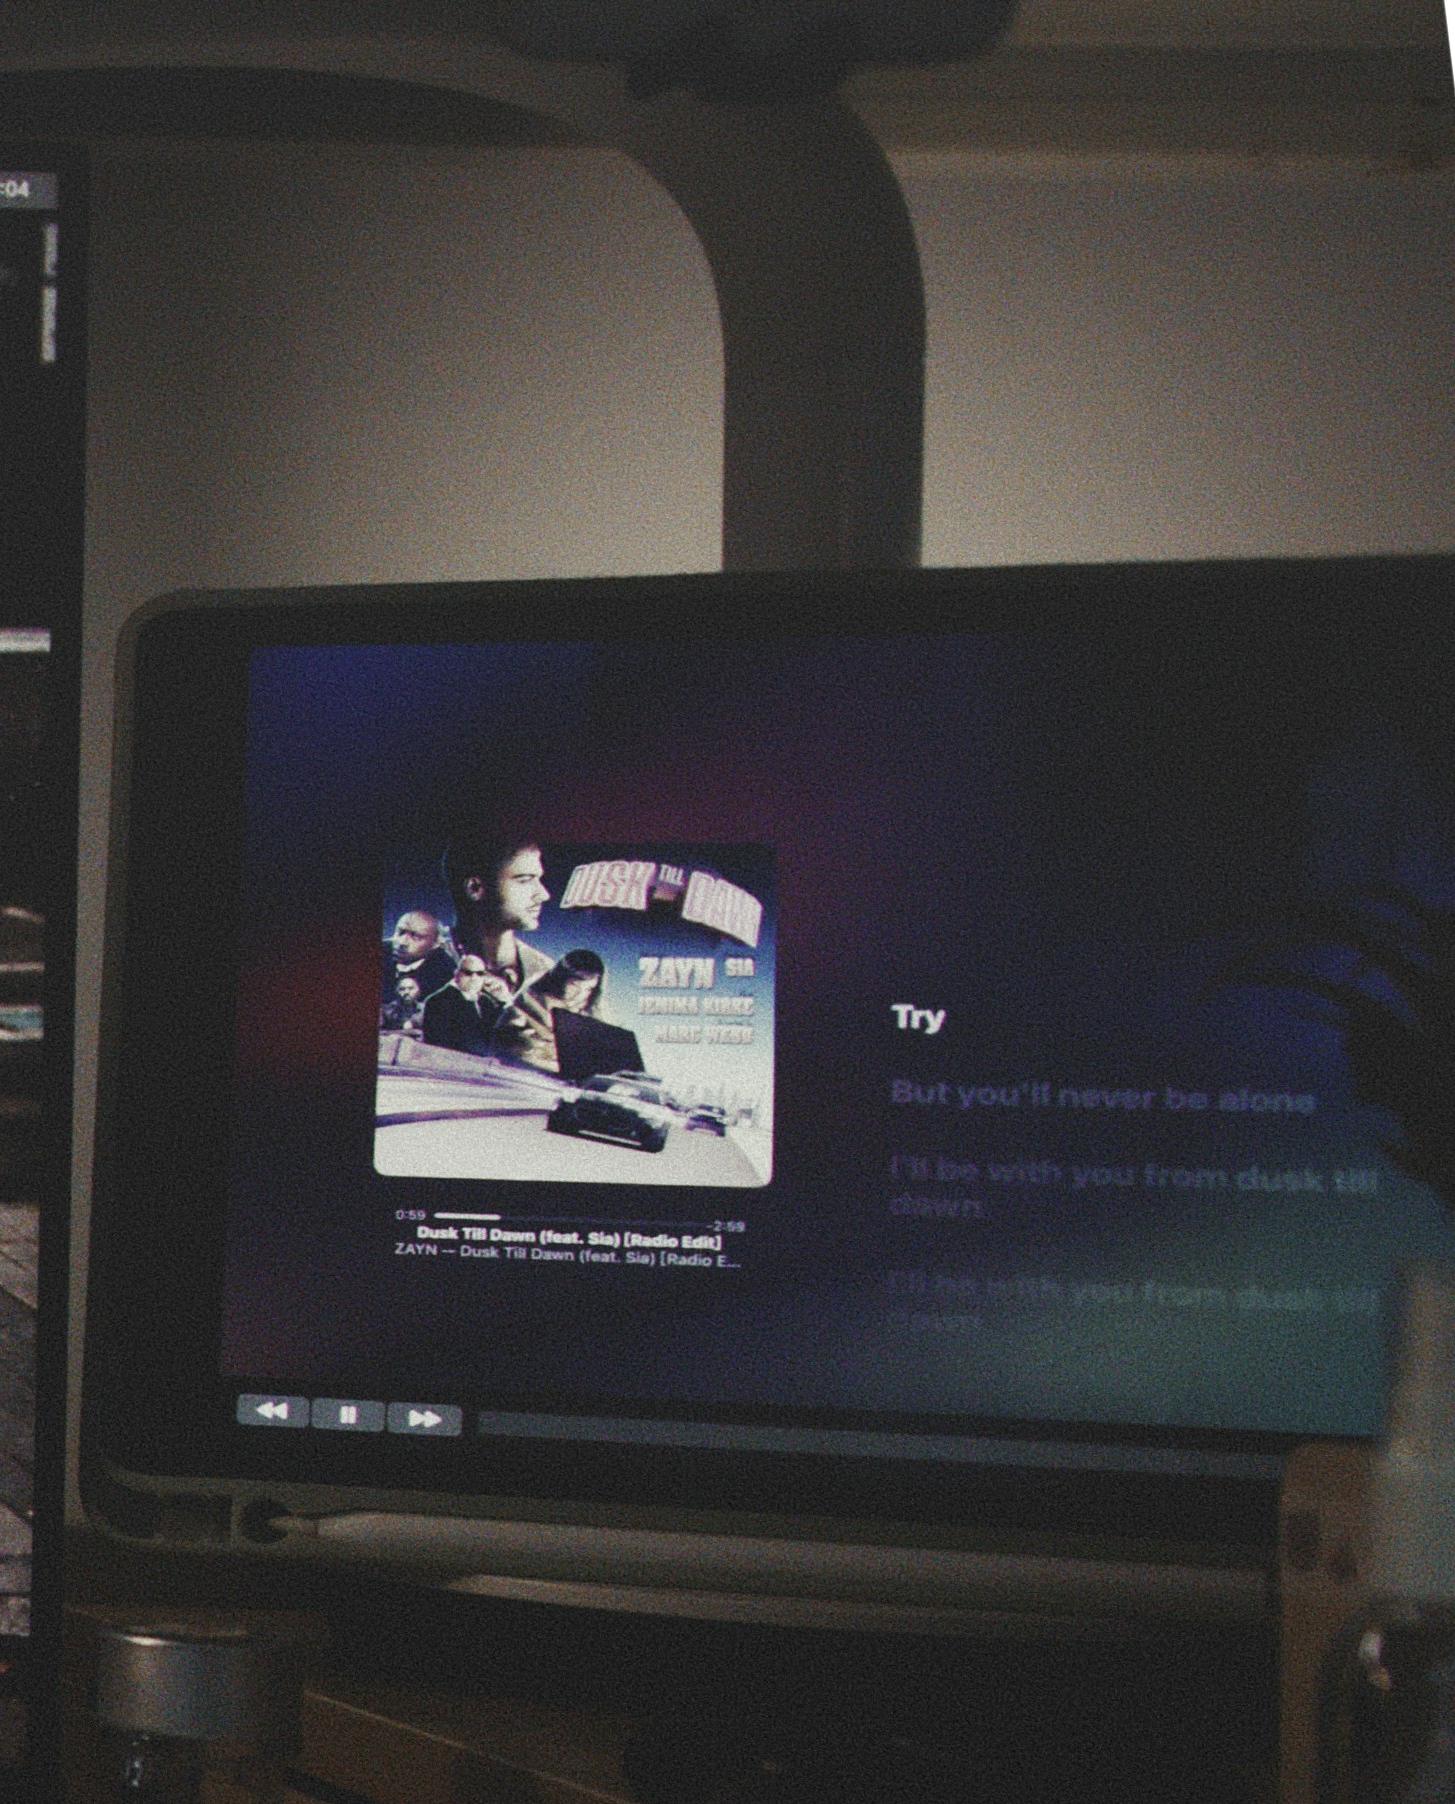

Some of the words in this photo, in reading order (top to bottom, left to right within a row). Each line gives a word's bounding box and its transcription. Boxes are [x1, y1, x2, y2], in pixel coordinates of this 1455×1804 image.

[638, 956, 716, 990] ZAYN
[891, 1002, 947, 1036] Try
[891, 1079, 949, 1104] But
[958, 1081, 1051, 1110] you'll
[1058, 1086, 1153, 1111] never
[1164, 1086, 1209, 1111] be
[1218, 1088, 1316, 1115] alone
[395, 1208, 426, 1221] 0:59
[417, 1225, 459, 1240] Dusk
[462, 1226, 487, 1241] Till
[490, 1227, 536, 1243] Dawn
[538, 1228, 583, 1246] (feat.
[587, 1230, 621, 1248] Sia)
[623, 1232, 679, 1249] [Radio
[682, 1234, 722, 1251] Edit]
[394, 1243, 437, 1256] ZAYN
[460, 1245, 500, 1259] Dusk
[505, 1246, 526, 1260] Till
[531, 1248, 575, 1262] Dawn
[578, 1248, 621, 1264] (feat.
[625, 1250, 656, 1266] Sia)
[660, 1252, 713, 1268] [Radio
